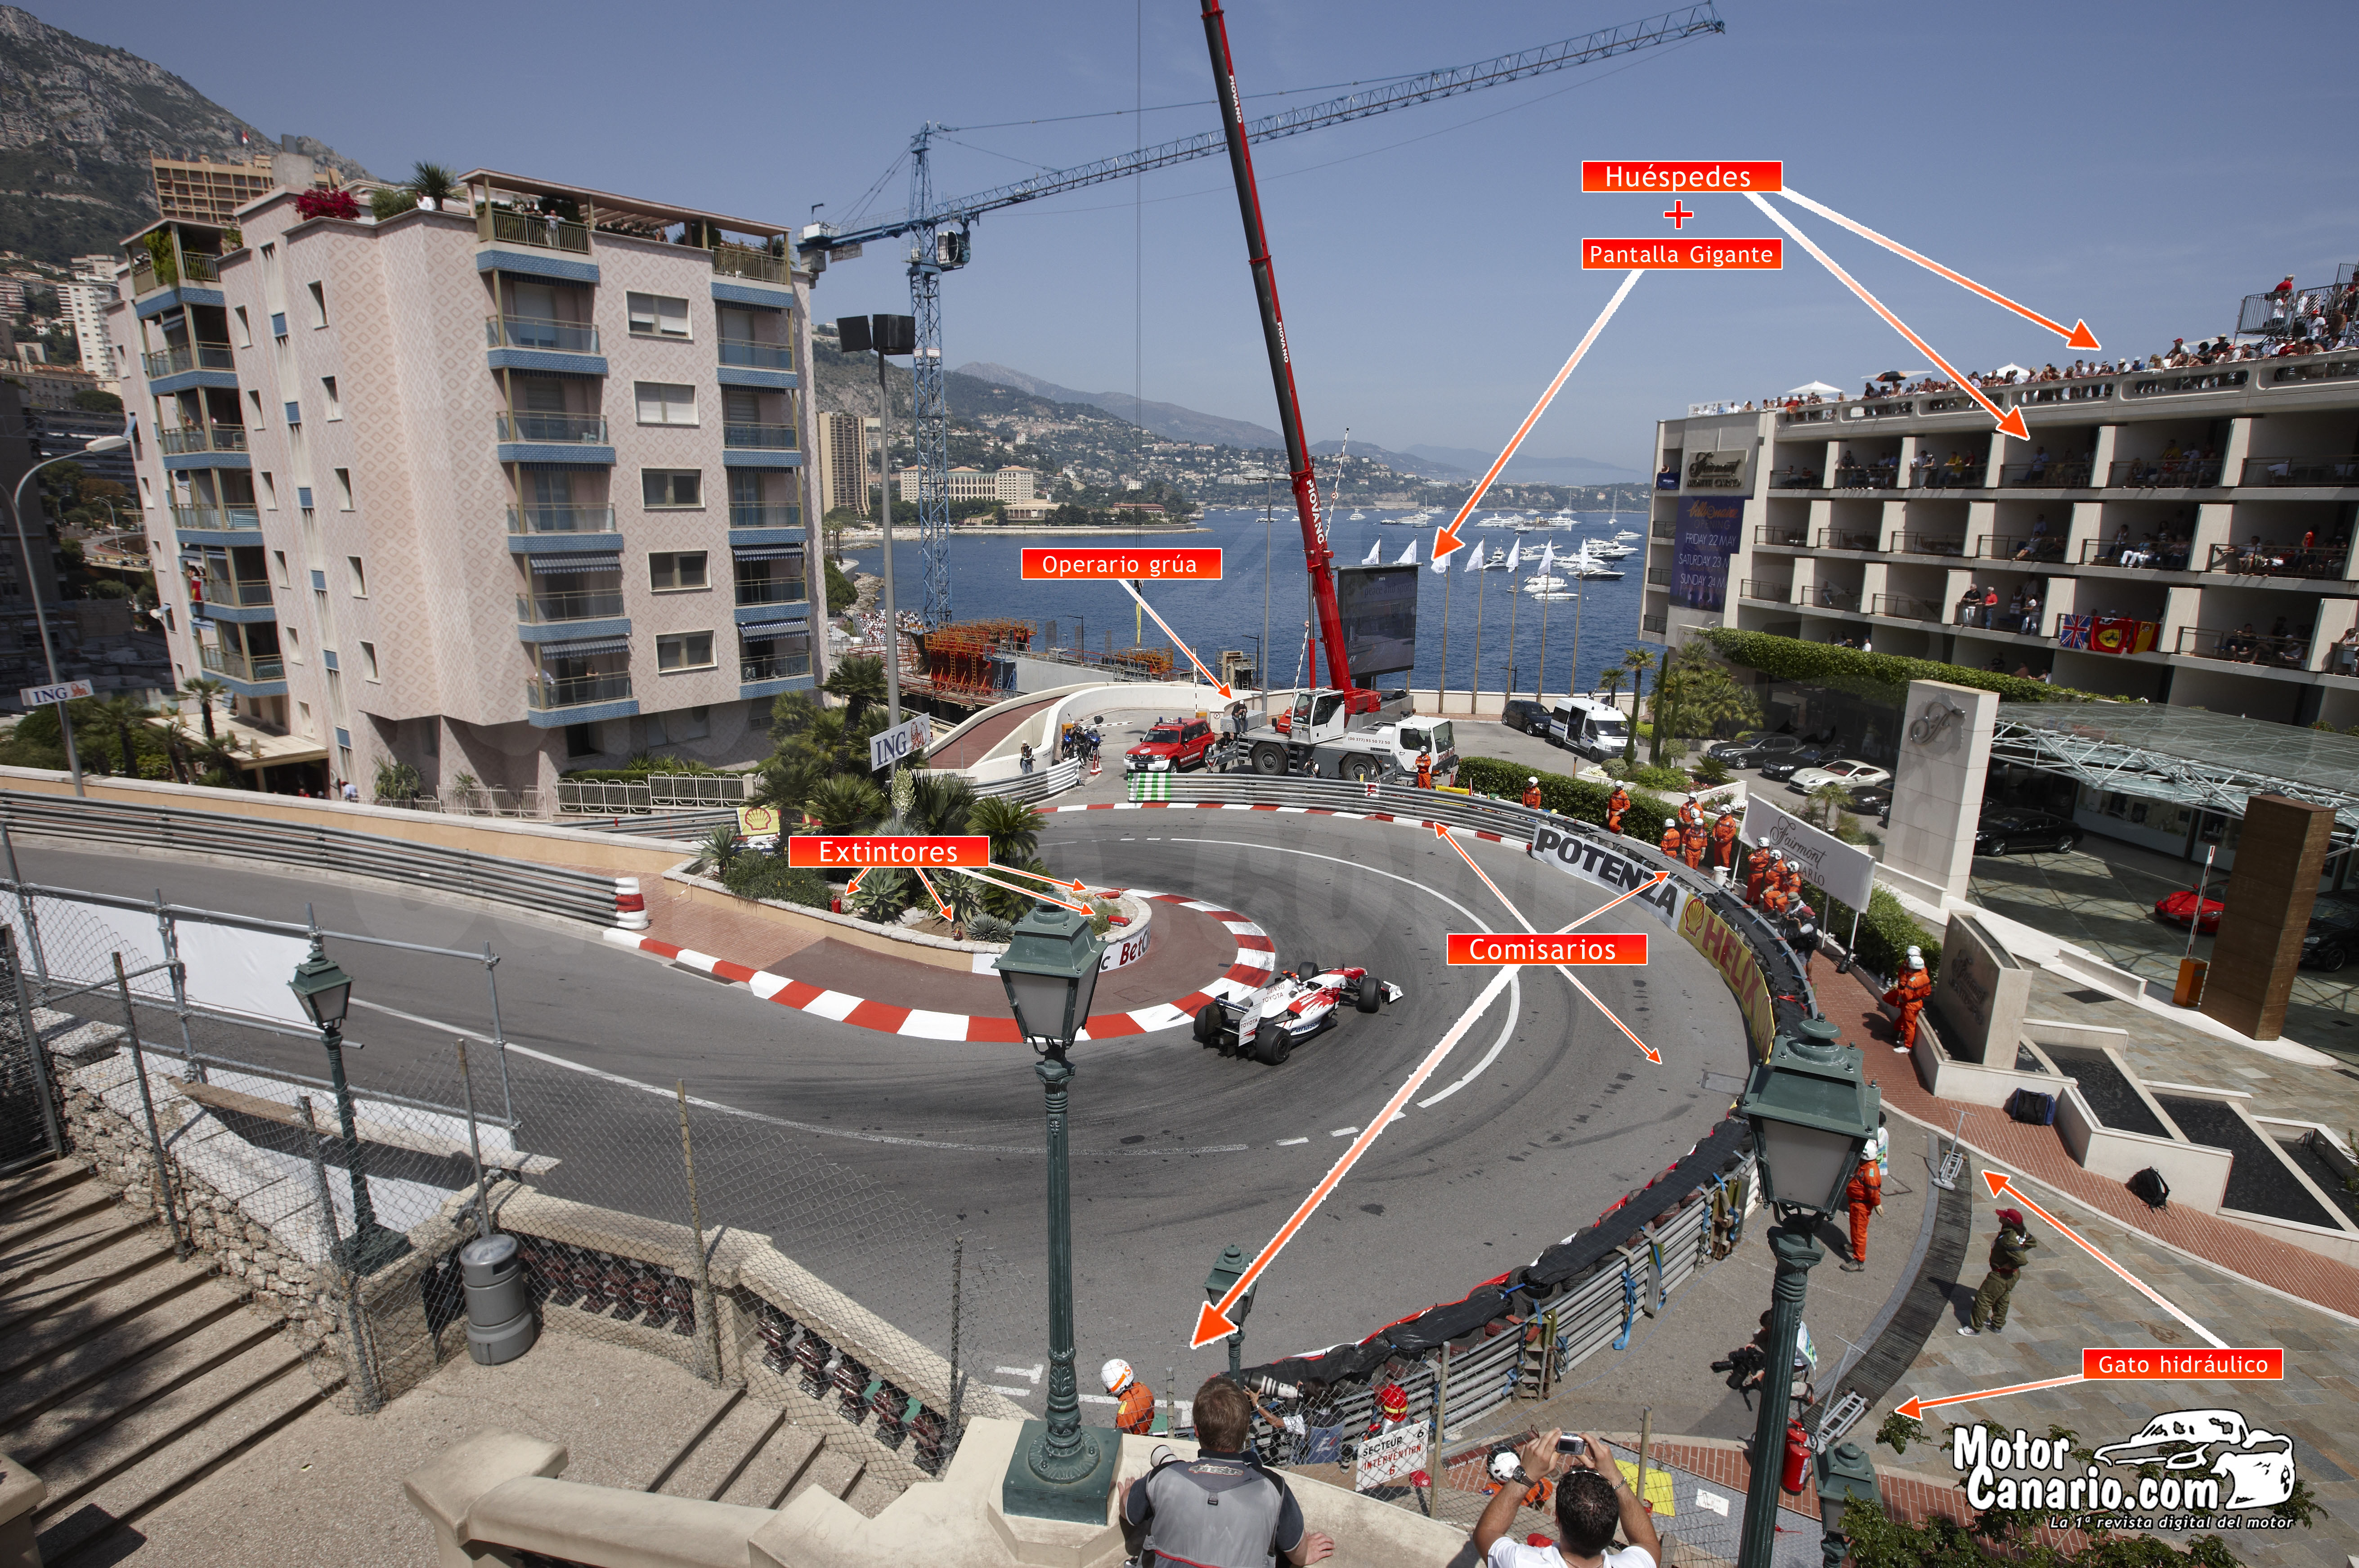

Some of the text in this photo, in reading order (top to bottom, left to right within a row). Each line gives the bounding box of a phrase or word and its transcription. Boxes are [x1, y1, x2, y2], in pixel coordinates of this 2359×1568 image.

[1228, 74, 1243, 124] PIOVANO
[1277, 320, 1290, 364] PIOVANO
[1306, 479, 1325, 545] PIOVANO
[1694, 519, 1731, 529] OPENING
[1686, 532, 1737, 547] FRIDAY 22 MAY
[1678, 553, 1711, 567] SATURDAY
[1712, 556, 1722, 568] 23
[1680, 573, 1707, 586] SUNDAY
[1708, 576, 1716, 587] 24
[1364, 586, 1382, 597] peace
[1384, 583, 1396, 594] and
[33, 686, 68, 703] ING
[875, 730, 908, 766] ING
[1438, 748, 1455, 763] PIOVANO
[1770, 815, 1827, 869] Fairmont
[1535, 828, 1678, 918] POTENZA
[1798, 862, 1825, 886] CARLO
[1702, 914, 1762, 1020] HELIX
[1267, 983, 1285, 995] DENSO
[1216, 997, 1249, 1012] Panasonic
[1262, 992, 1284, 1003] TOYOTA
[1240, 1017, 1258, 1029] TOYOTA
[1417, 1429, 1424, 1438] 6
[1363, 1436, 1403, 1456] SECTEUR
[1364, 1443, 1422, 1471] INTERVENTION
[1448, 1456, 1483, 1471] GRAND HOTEL
[1389, 1465, 1395, 1475] 6
